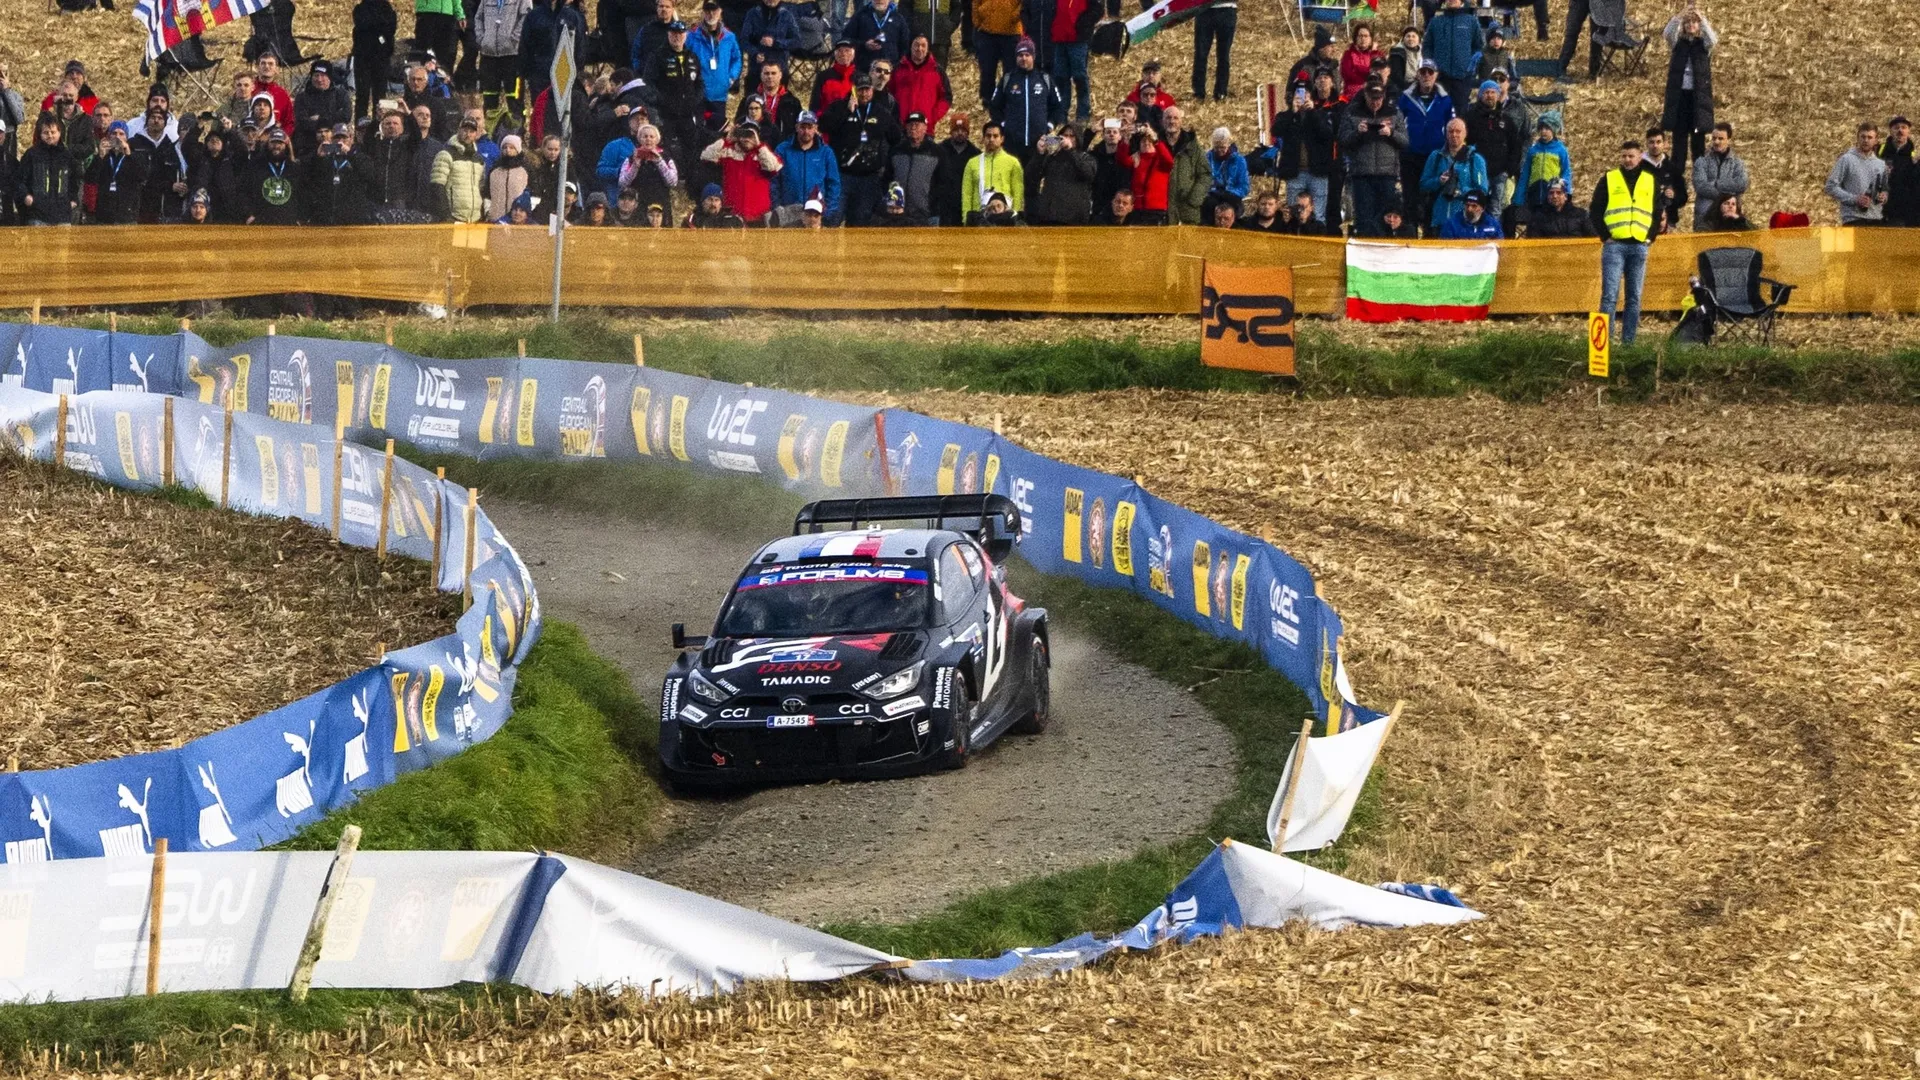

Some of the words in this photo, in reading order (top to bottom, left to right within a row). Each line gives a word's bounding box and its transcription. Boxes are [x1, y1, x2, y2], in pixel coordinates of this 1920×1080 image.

[785, 563, 829, 571] TOYOTA
[757, 661, 842, 674] DENSO
[761, 676, 831, 687] TAMADIC
